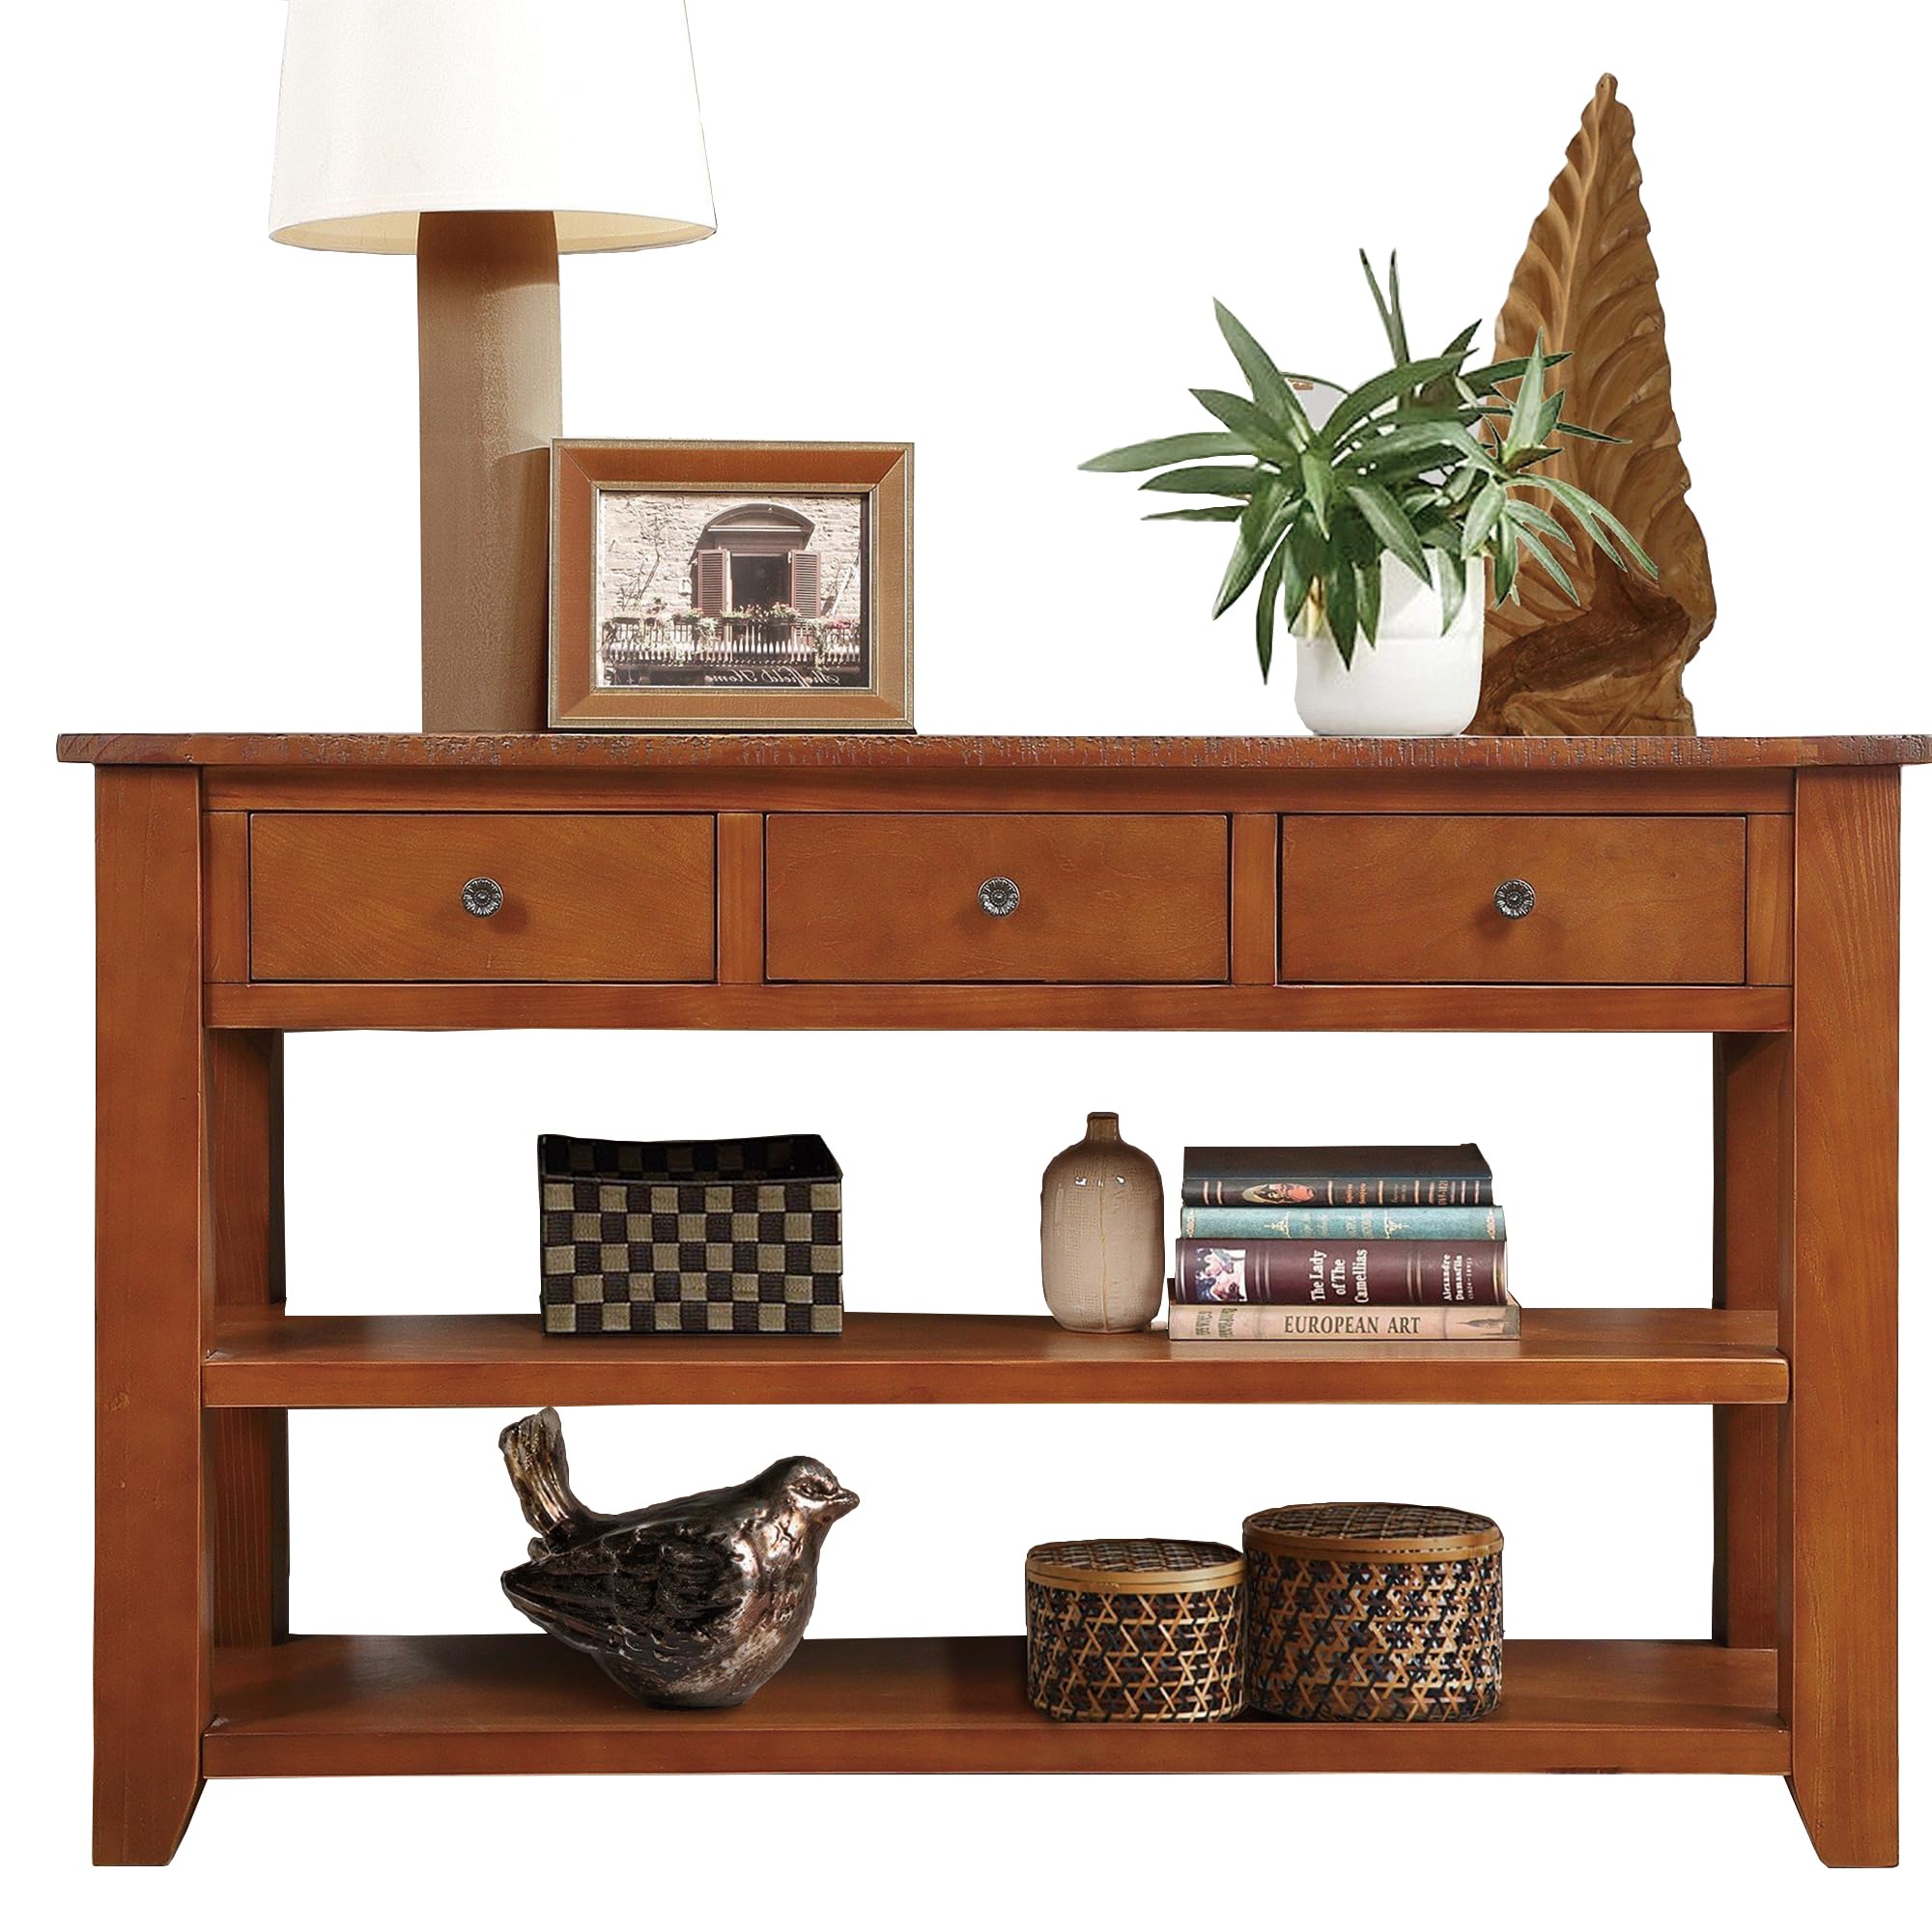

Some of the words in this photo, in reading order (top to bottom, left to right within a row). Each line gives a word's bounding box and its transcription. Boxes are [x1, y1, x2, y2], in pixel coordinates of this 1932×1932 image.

[1309, 1250, 1327, 1280] Lady
[1330, 1259, 1346, 1283] The
[1351, 1249, 1369, 1303] Camellias
[1331, 1283, 1347, 1295] of
[1441, 1254, 1452, 1301] Alexandre
[1310, 1281, 1326, 1301] The
[1284, 1315, 1378, 1334] EUROPEAN
[1387, 1316, 1421, 1334] ART
